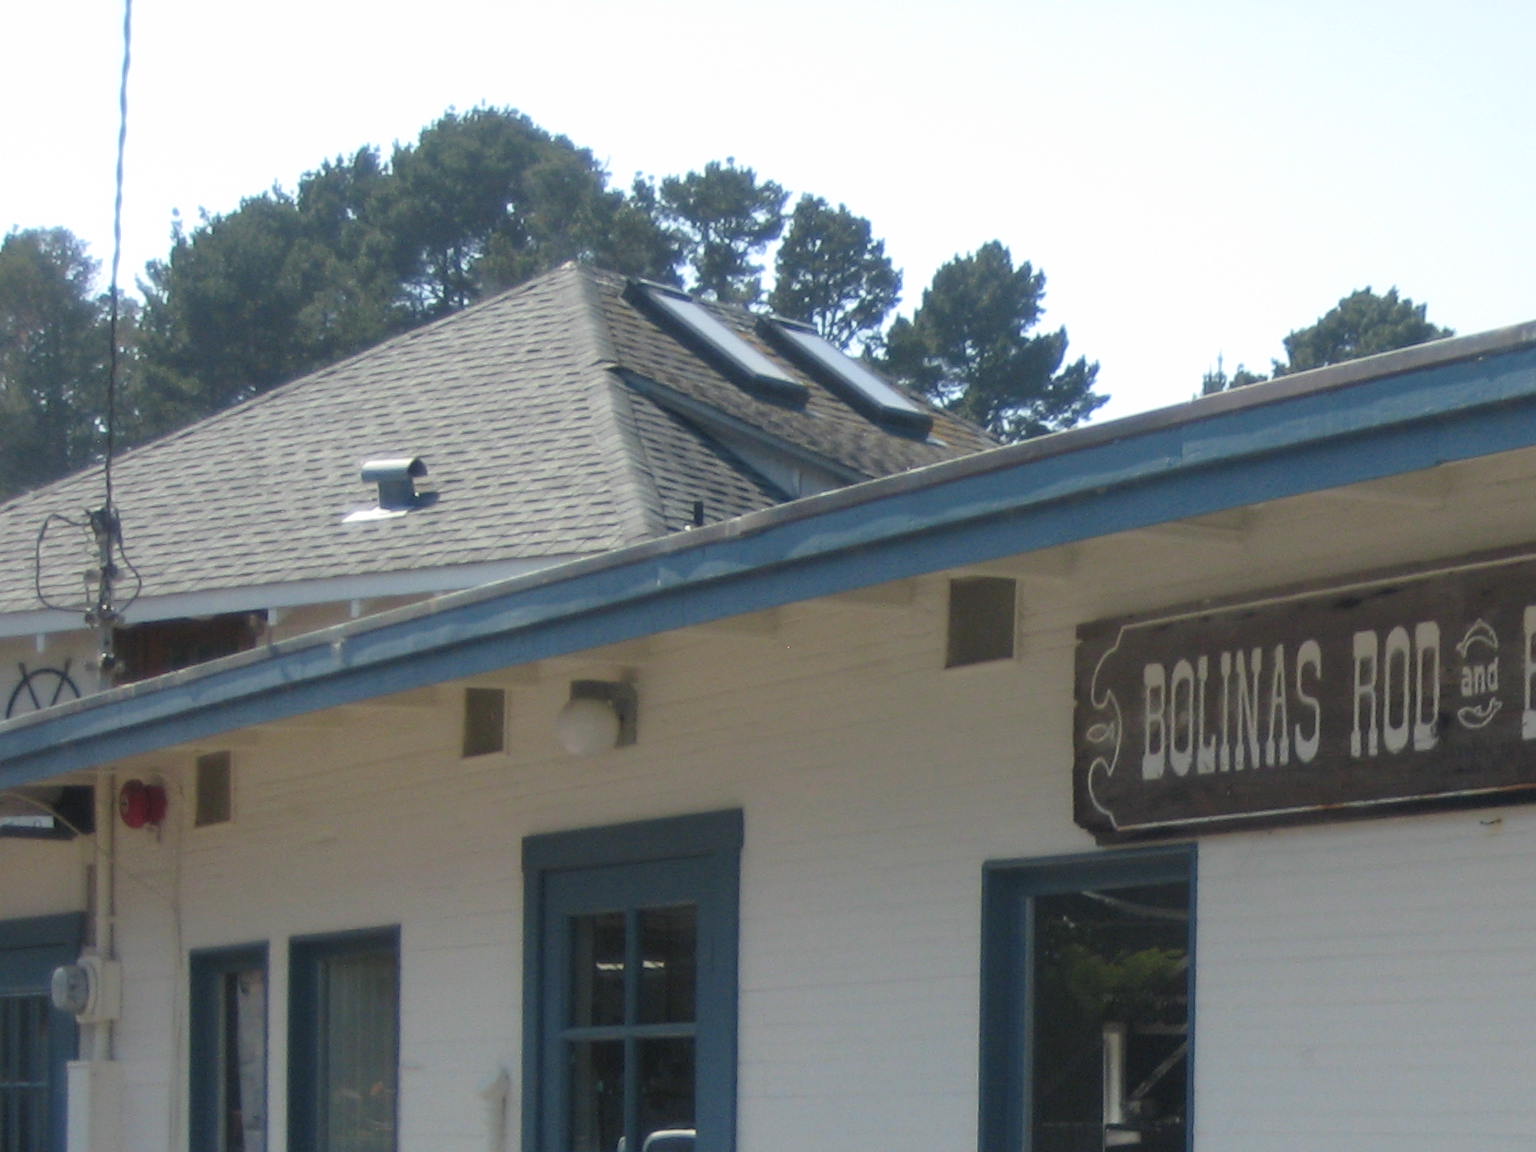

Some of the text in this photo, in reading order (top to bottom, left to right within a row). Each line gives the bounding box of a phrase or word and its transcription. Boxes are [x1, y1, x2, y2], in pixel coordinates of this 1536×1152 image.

[1142, 640, 1322, 780] BOLINAS
[1351, 621, 1440, 758] ROD
[1461, 657, 1499, 697] and
